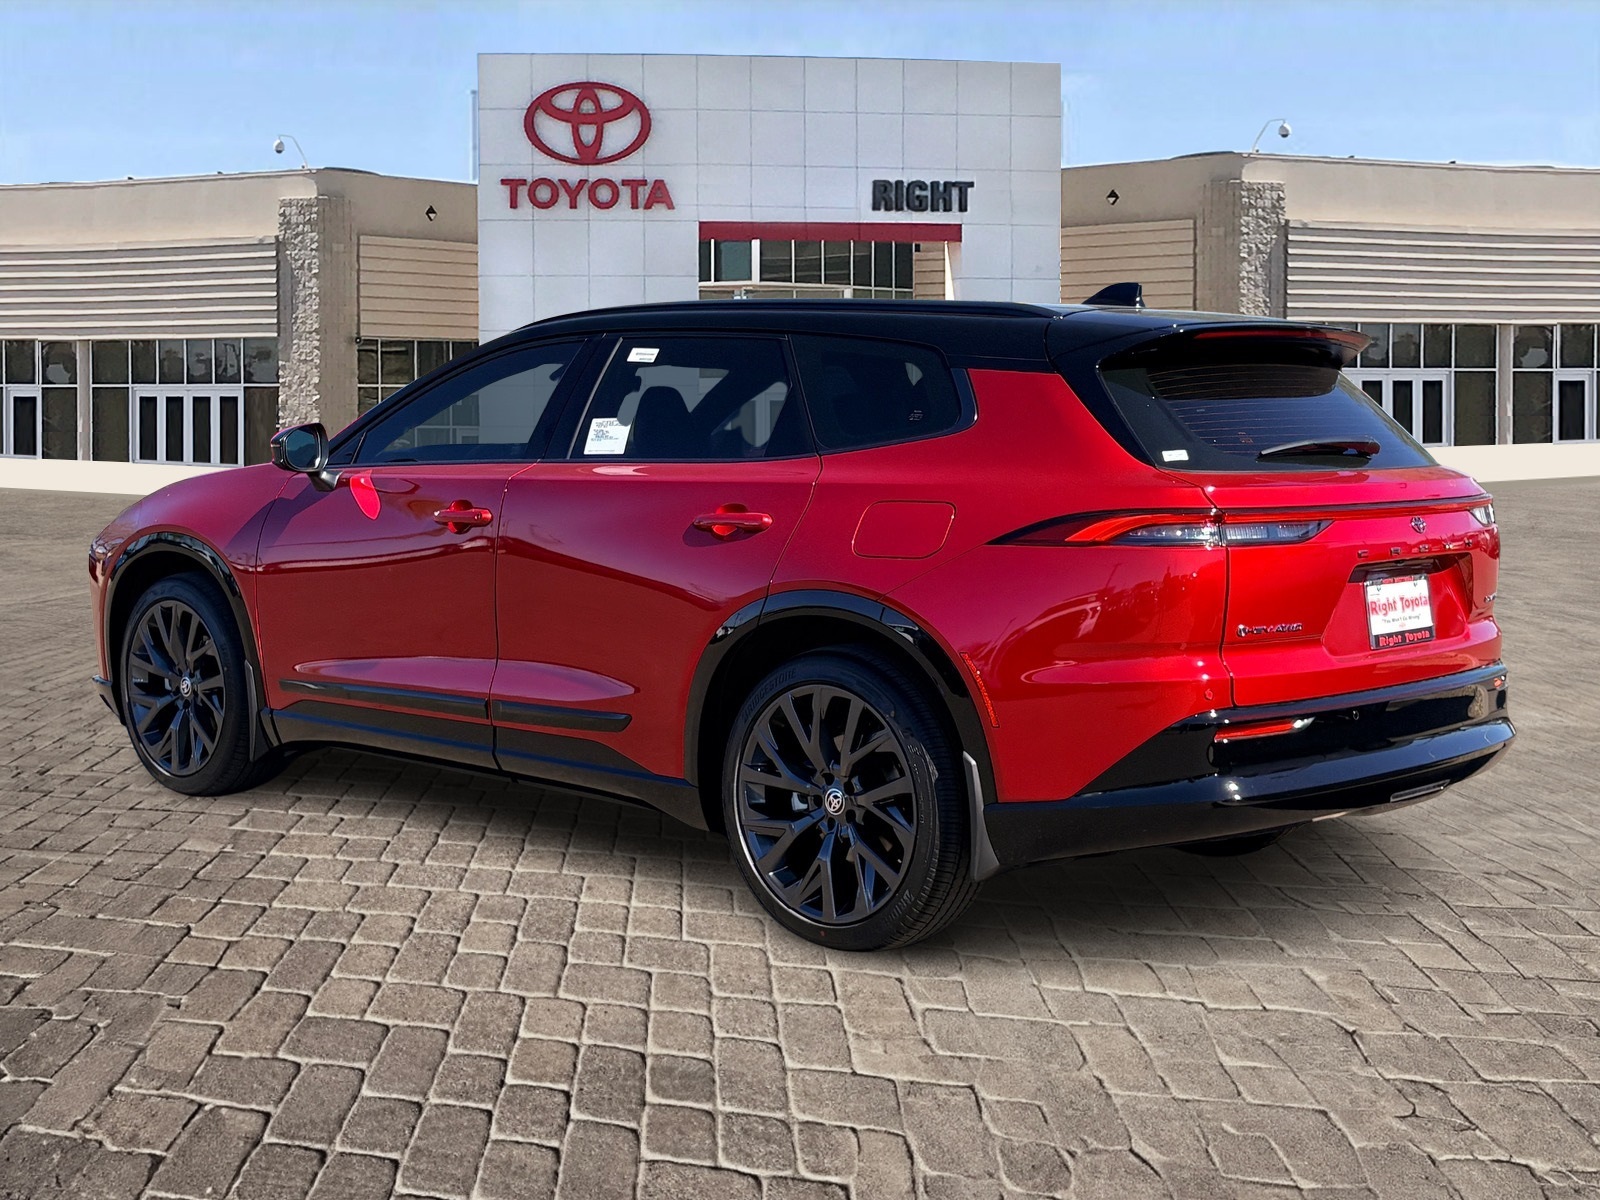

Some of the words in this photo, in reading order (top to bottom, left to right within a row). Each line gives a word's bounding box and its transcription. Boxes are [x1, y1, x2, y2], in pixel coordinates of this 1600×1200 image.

[500, 178, 676, 210] TOYOTA
[871, 179, 975, 213] RIGHT
[1369, 596, 1397, 617] Right
[1399, 593, 1429, 612] Toyota
[1379, 634, 1402, 647] Right
[1405, 630, 1430, 643] Toyota
